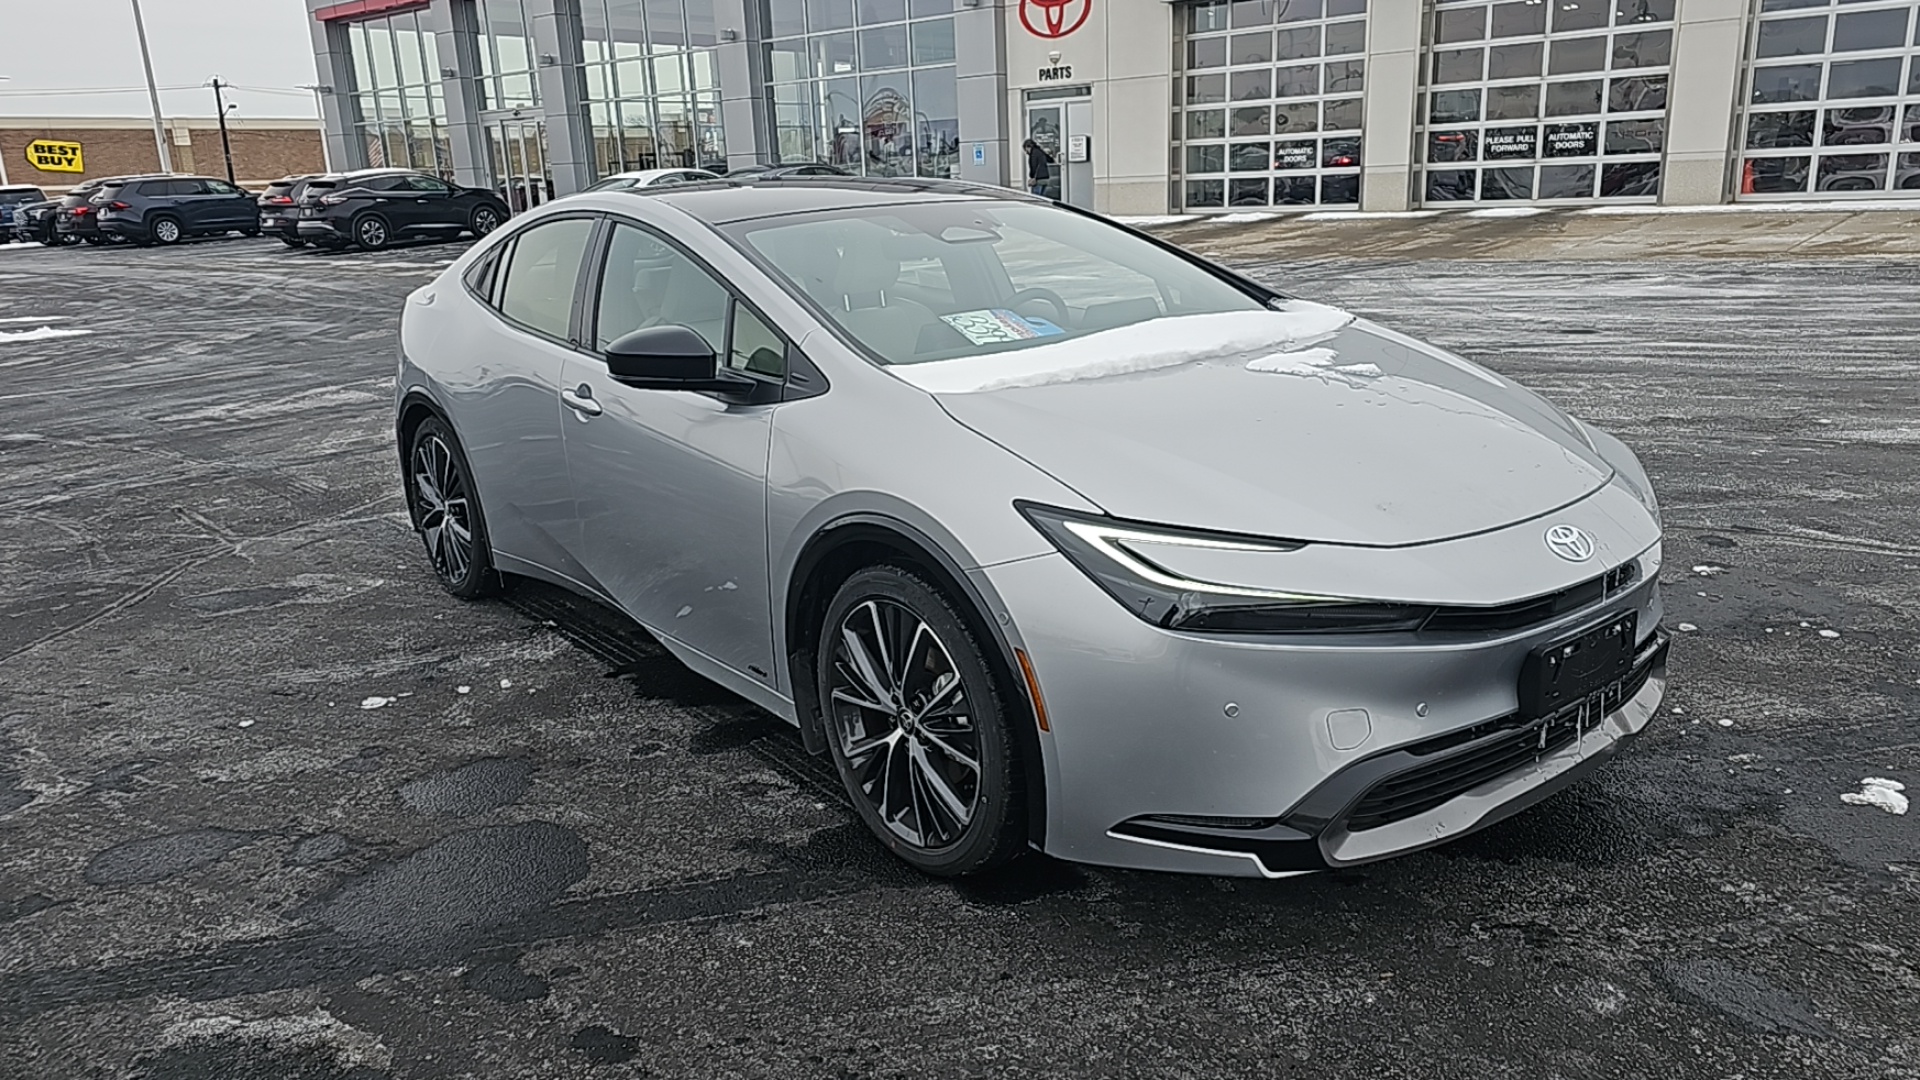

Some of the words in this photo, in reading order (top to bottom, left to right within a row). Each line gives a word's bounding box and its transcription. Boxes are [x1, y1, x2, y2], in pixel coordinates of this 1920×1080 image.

[1038, 66, 1072, 81] PARTS
[1486, 135, 1514, 144] PLEASE
[1516, 134, 1536, 142] PULL
[1547, 131, 1594, 141] AUTOMATIC
[33, 144, 79, 156] BEST
[1491, 143, 1529, 152] FORWARD
[1555, 141, 1585, 150] DOORS
[1278, 146, 1314, 156] AUTOMATIC
[37, 155, 76, 167] BUY
[1283, 154, 1308, 163] DOORS
